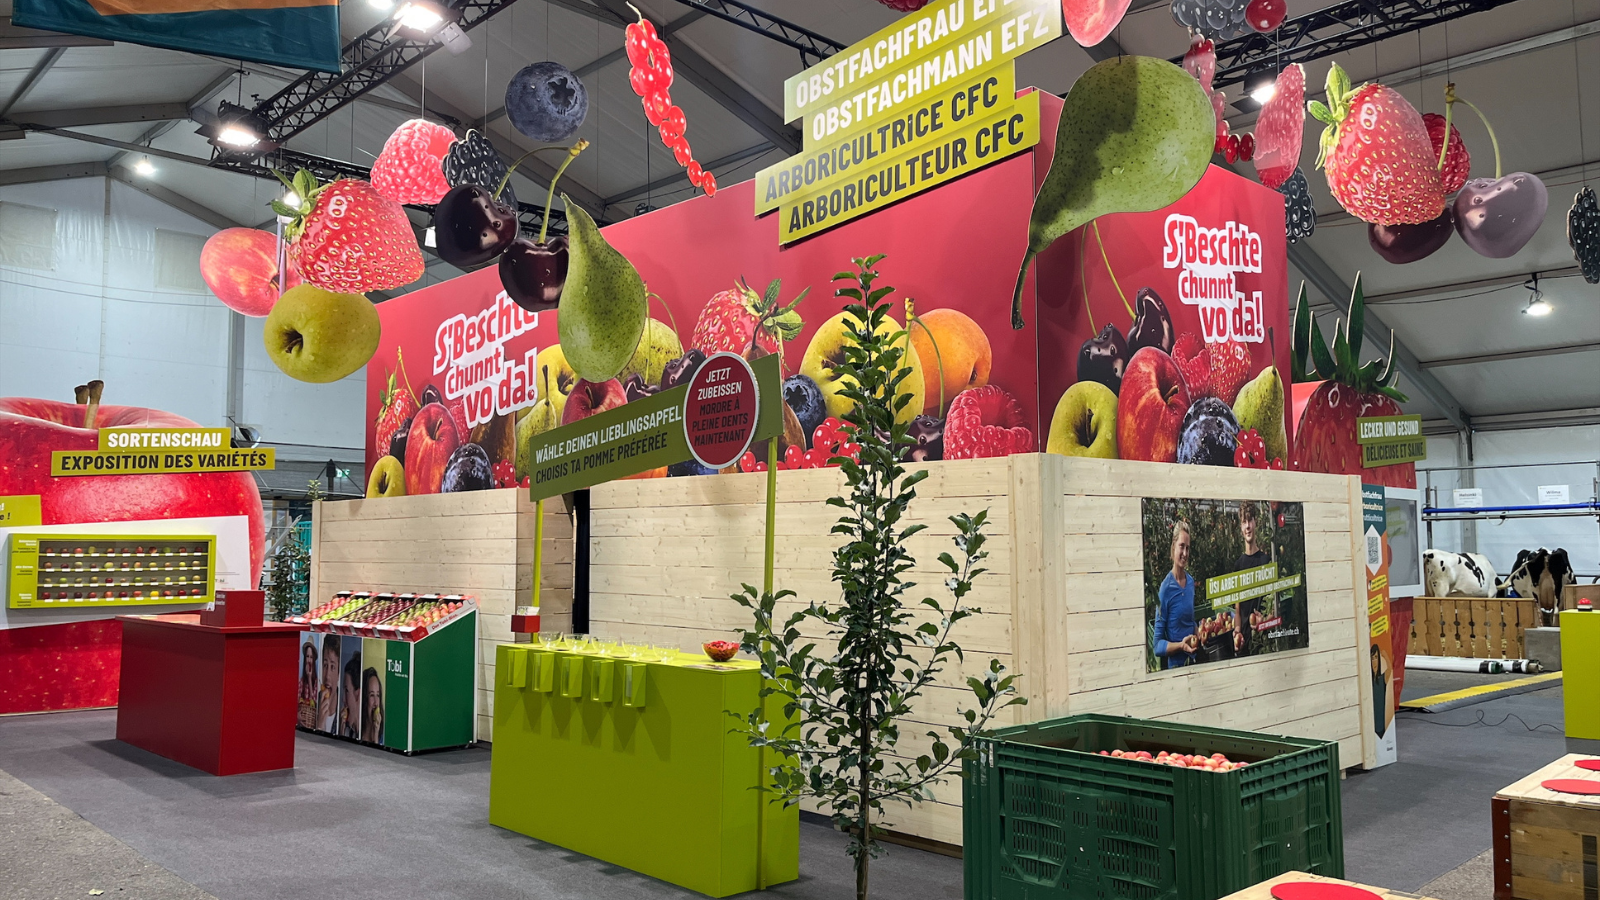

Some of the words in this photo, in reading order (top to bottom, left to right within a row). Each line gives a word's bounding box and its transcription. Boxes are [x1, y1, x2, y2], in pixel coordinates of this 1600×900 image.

[796, 0, 964, 109] OBSTFACHFRAU
[812, 30, 992, 141] OBSTFACHMANN
[1001, 2, 1049, 55] EFZ
[765, 100, 944, 203] ARBORICULTRICE
[951, 76, 998, 122] CFC
[788, 137, 968, 234] ARBORICULTEUR
[975, 113, 1024, 159] CFC
[1166, 218, 1260, 269] S'Beschte
[1180, 269, 1234, 300] chunnt
[1201, 306, 1227, 338] vo
[1231, 296, 1263, 338] da!
[447, 347, 501, 395] chunnt
[705, 367, 732, 384] JETZT
[465, 385, 493, 424] vo
[498, 354, 536, 410] da!
[697, 381, 742, 401] ZUBEISSEN
[699, 399, 732, 416] MORDRE
[733, 396, 741, 411] À
[535, 441, 564, 465] WÄHLE
[565, 432, 598, 454] DEINEN
[600, 404, 682, 444] LIEBLINGSAPFEL
[692, 417, 719, 433] PLEINE
[721, 412, 749, 429] DENTS
[694, 428, 746, 447] MAINTENANT
[1360, 421, 1384, 439] LECKER
[1384, 421, 1397, 437] UND
[1397, 420, 1419, 436] GESUND
[107, 432, 222, 448] SORTENSCHAU
[1365, 443, 1399, 461] DÉLICIEUSE
[1400, 443, 1407, 457] ET
[1407, 441, 1424, 458] SAINE
[61, 454, 159, 471] EXPOSITION
[164, 453, 194, 469] DES
[198, 450, 267, 468] VARIÉTÉS
[536, 461, 569, 485] CHOISIS
[570, 458, 582, 474] TA
[583, 449, 615, 471] POMME
[617, 430, 668, 459] PRÉFÉRÉE
[1209, 577, 1220, 595] ÜSI
[1255, 566, 1276, 583] FRÜCHT
[387, 659, 402, 673] Tobi
